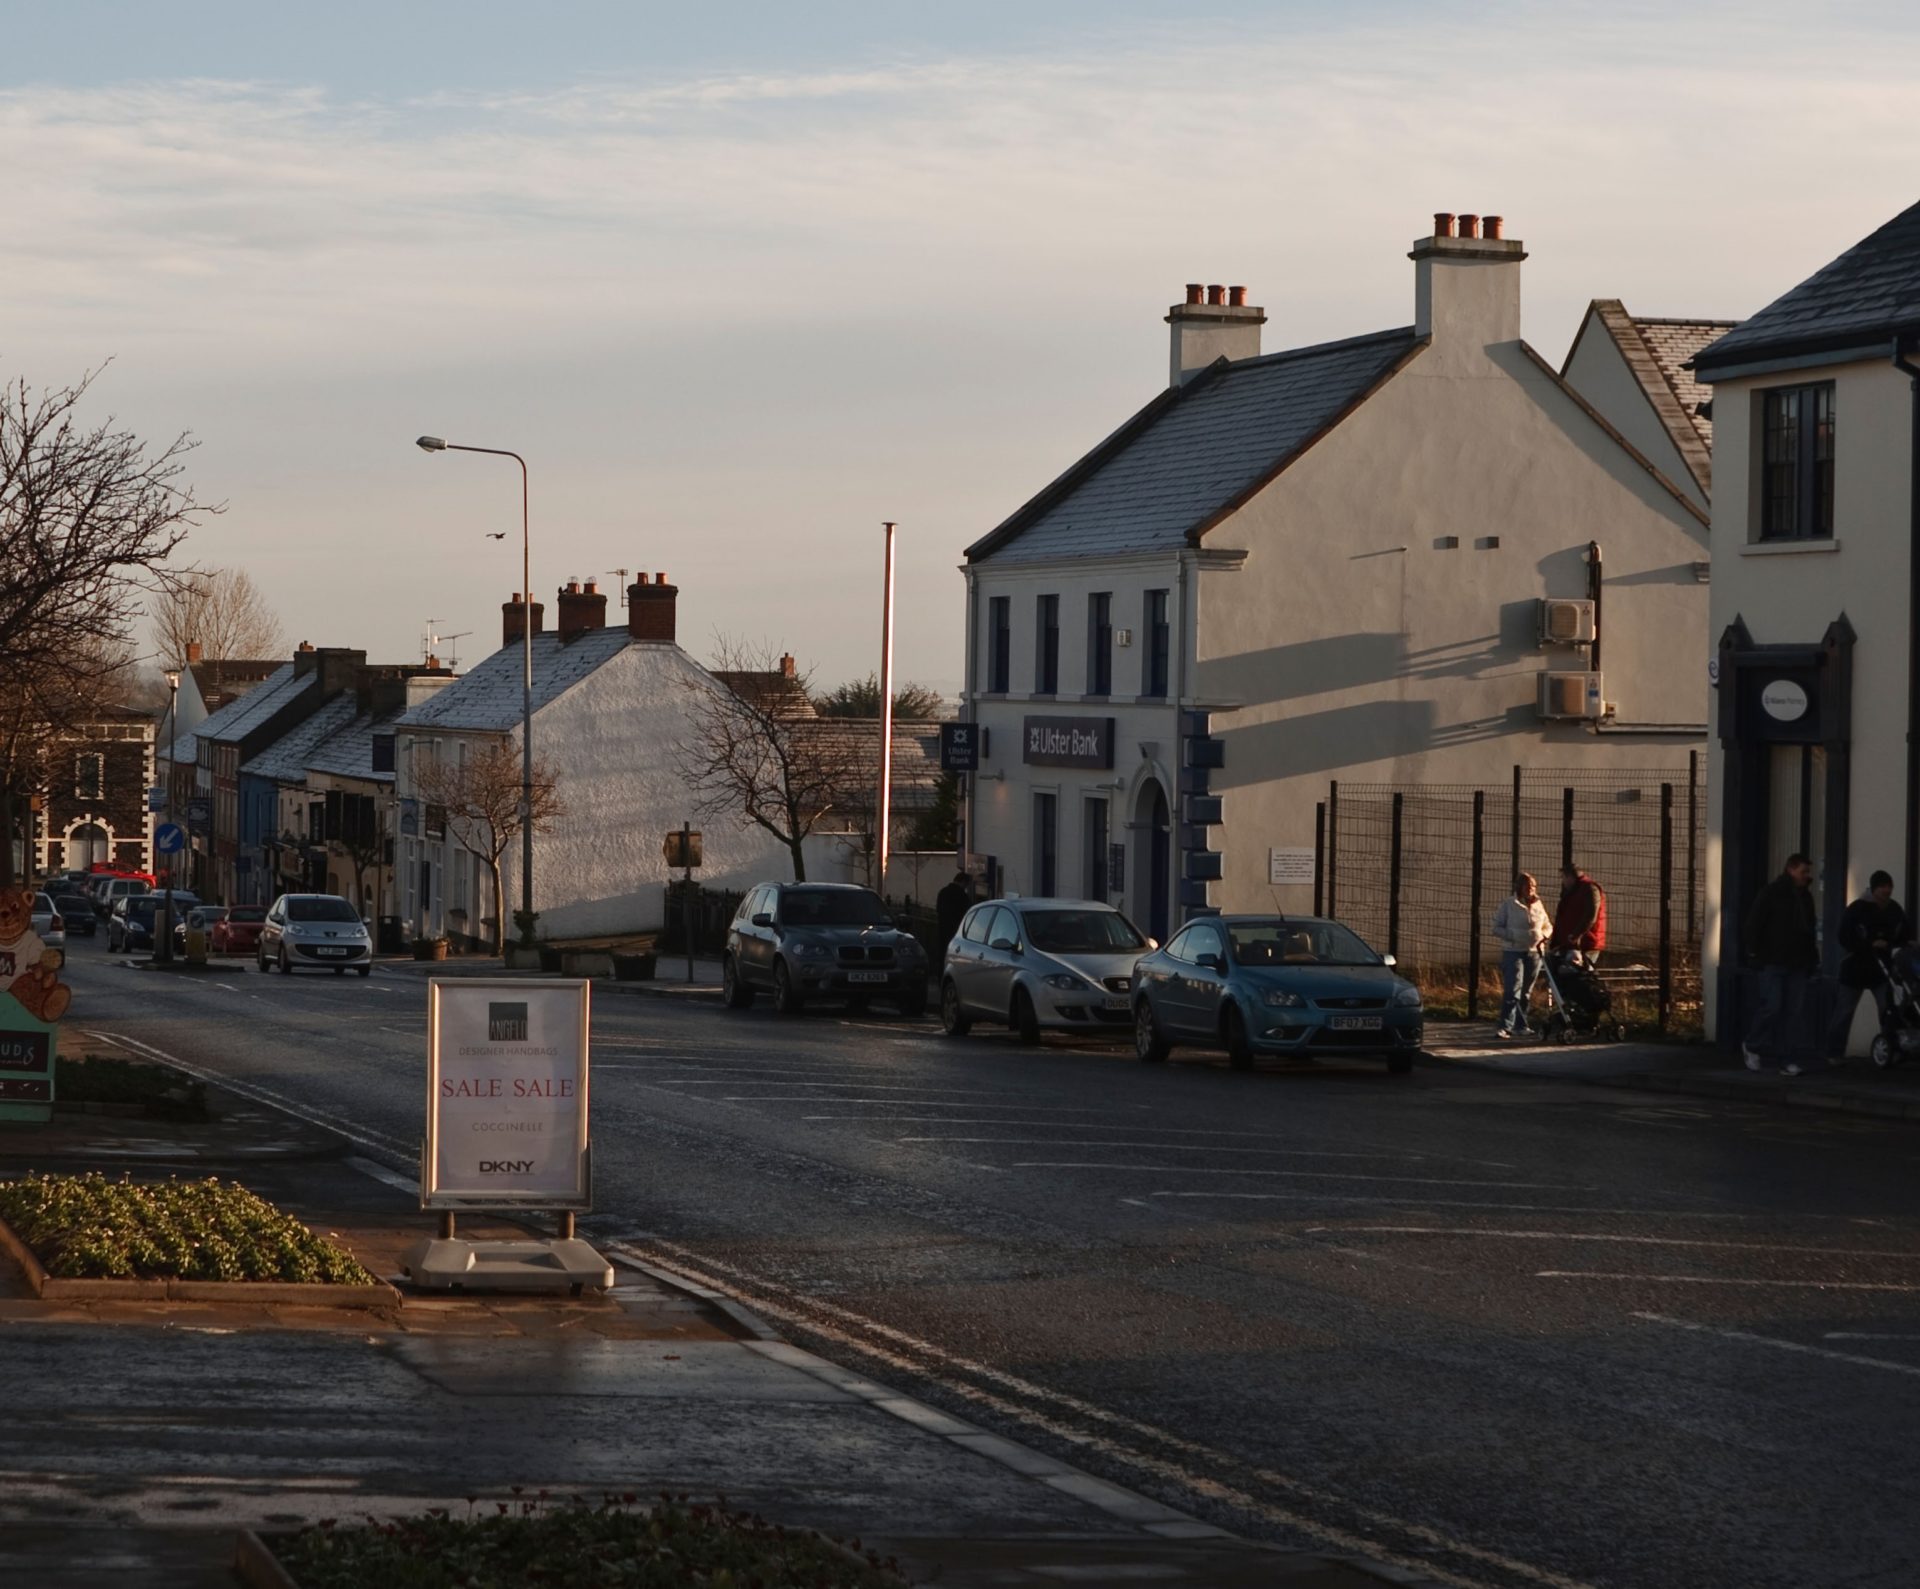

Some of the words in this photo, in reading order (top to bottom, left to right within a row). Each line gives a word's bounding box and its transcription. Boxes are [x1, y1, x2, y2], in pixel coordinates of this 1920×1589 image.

[1040, 727, 1071, 754] Ulster
[1072, 728, 1099, 757] Bank
[490, 1019, 528, 1041] ANGELO
[459, 1047, 505, 1056] DESIGNER
[506, 1047, 559, 1056] HANDBAGS
[442, 1079, 503, 1097] SALE
[514, 1079, 574, 1097] SALE
[472, 1122, 543, 1132] COCCINELLE
[479, 1160, 534, 1172] DKNY
